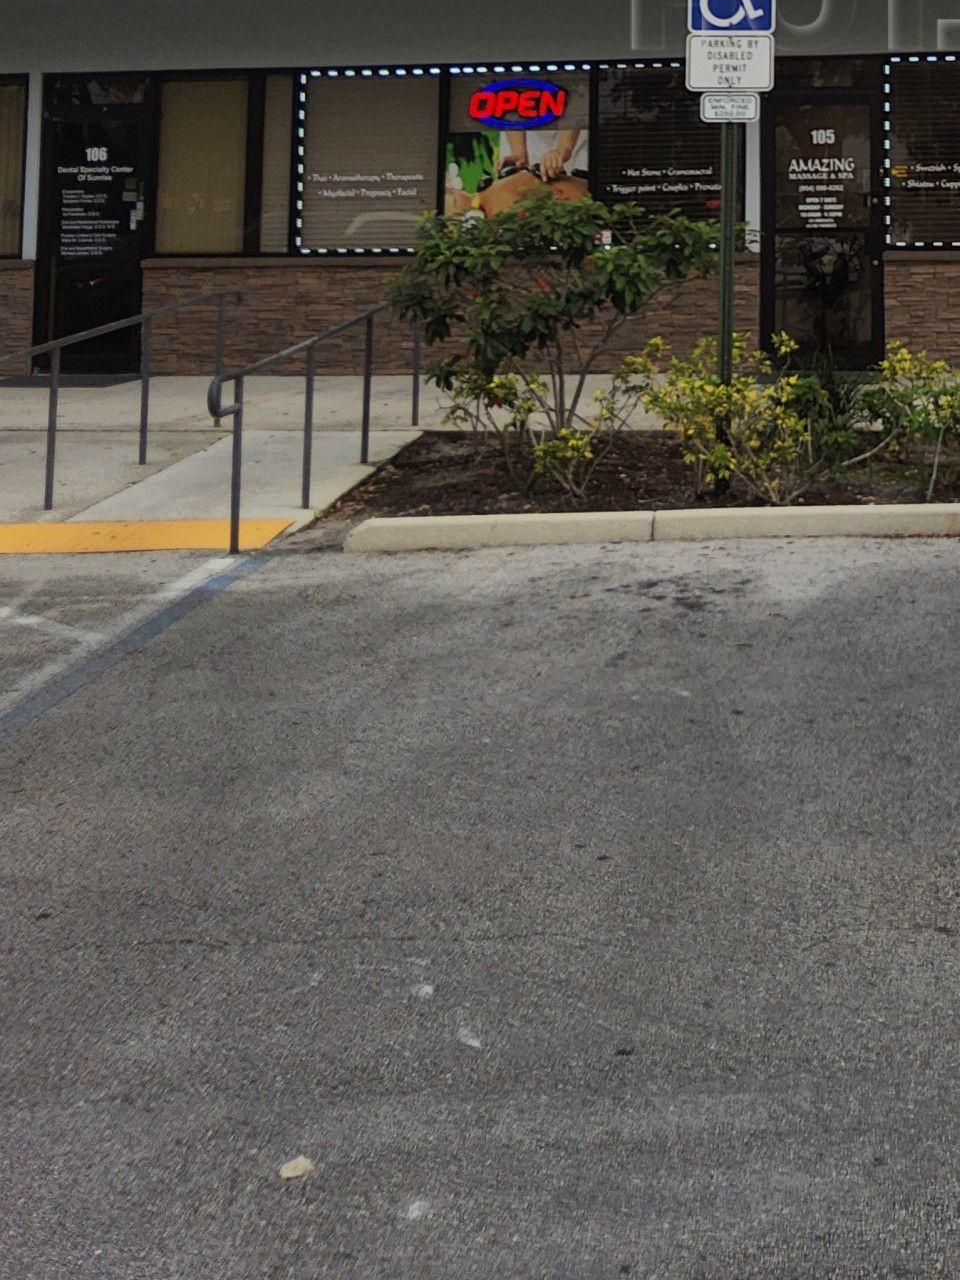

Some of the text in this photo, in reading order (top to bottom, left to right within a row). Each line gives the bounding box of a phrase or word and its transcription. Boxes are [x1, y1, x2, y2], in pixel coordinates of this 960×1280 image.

[700, 39, 760, 49] PARKING BY
[707, 51, 753, 61] DISABLED
[712, 64, 747, 74] PERMIT
[717, 76, 743, 85] ONLY
[469, 89, 565, 118] OPEN
[810, 128, 836, 145] 105
[85, 147, 108, 161] 106
[788, 157, 855, 172] AMAZING
[57, 166, 79, 174] Dental
